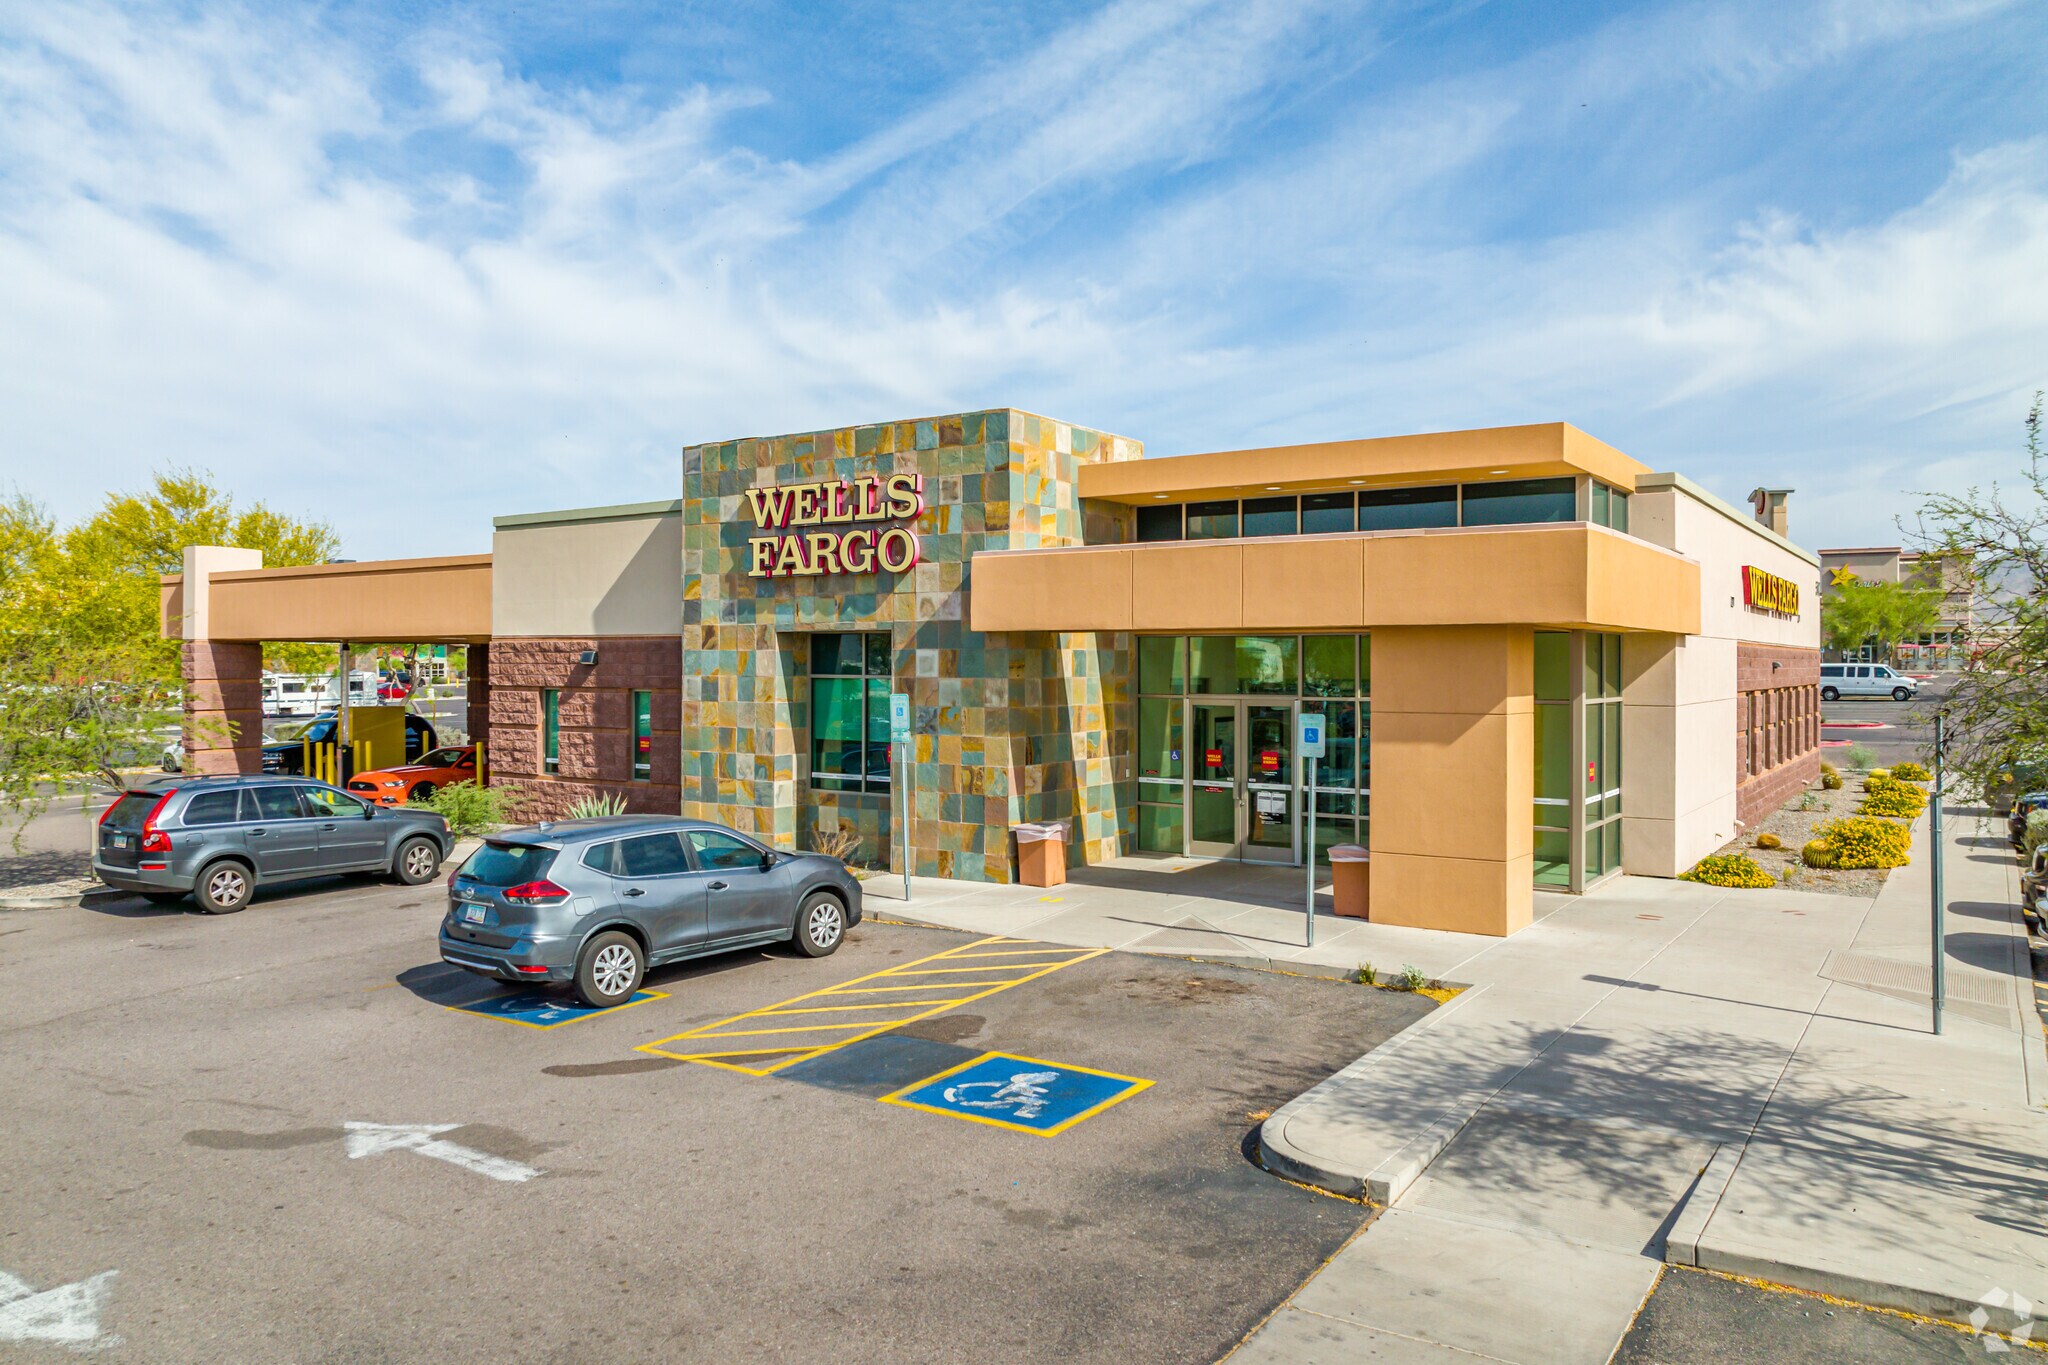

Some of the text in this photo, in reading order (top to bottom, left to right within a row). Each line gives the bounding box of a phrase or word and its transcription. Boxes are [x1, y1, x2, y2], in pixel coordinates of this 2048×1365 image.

[745, 474, 922, 529] WELLS
[748, 528, 919, 578] FARGO
[1748, 565, 1799, 616] WELLS FARGO
